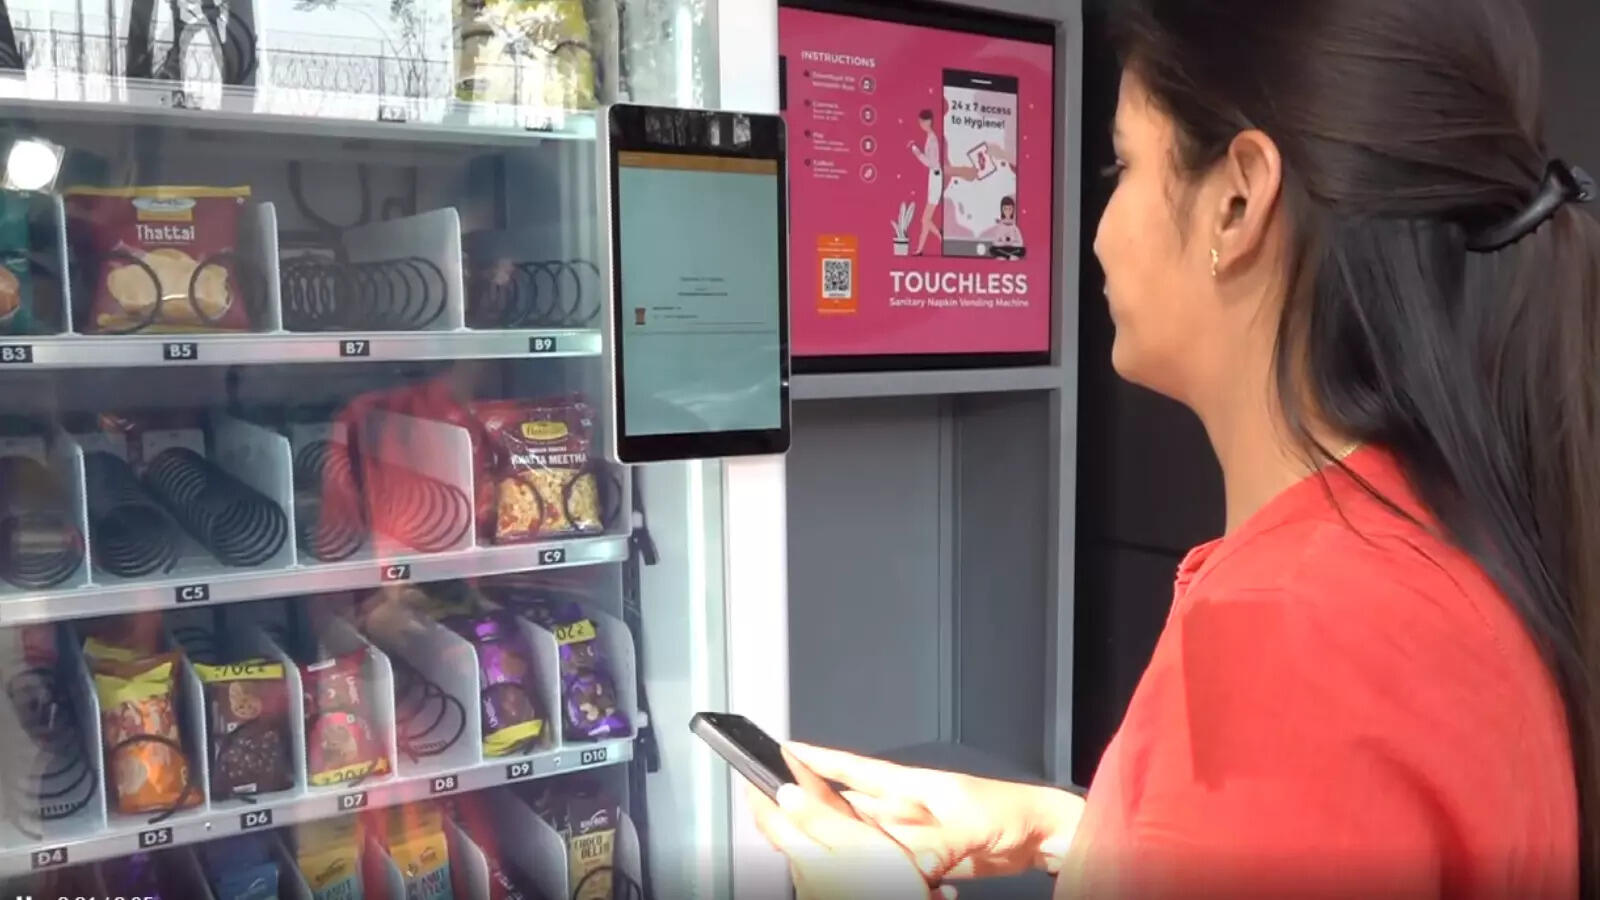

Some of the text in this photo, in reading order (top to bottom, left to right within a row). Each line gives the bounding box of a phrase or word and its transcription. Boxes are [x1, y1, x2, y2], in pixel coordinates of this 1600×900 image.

[801, 51, 875, 68] INSTRUCTIONS
[952, 100, 1011, 116] 24 x 7 access
[951, 115, 1005, 129] to Hygiene!
[136, 225, 195, 240] Thattai
[889, 271, 1028, 294] TOUCHLESS
[889, 297, 1029, 308] Sanitary Napkin Vending Machine
[170, 344, 191, 358] B5
[346, 341, 364, 354] B7
[535, 338, 552, 351] B9
[2, 347, 26, 361] B3
[549, 452, 588, 465] MEETHA
[544, 551, 561, 563] C9
[386, 565, 405, 578] C7
[182, 586, 204, 600] C5
[583, 749, 606, 762] D10
[511, 763, 529, 776] D9
[435, 777, 454, 790] D8
[343, 793, 363, 808] D7
[247, 811, 267, 826] D6
[144, 829, 168, 844] D5
[37, 849, 61, 864] D4
